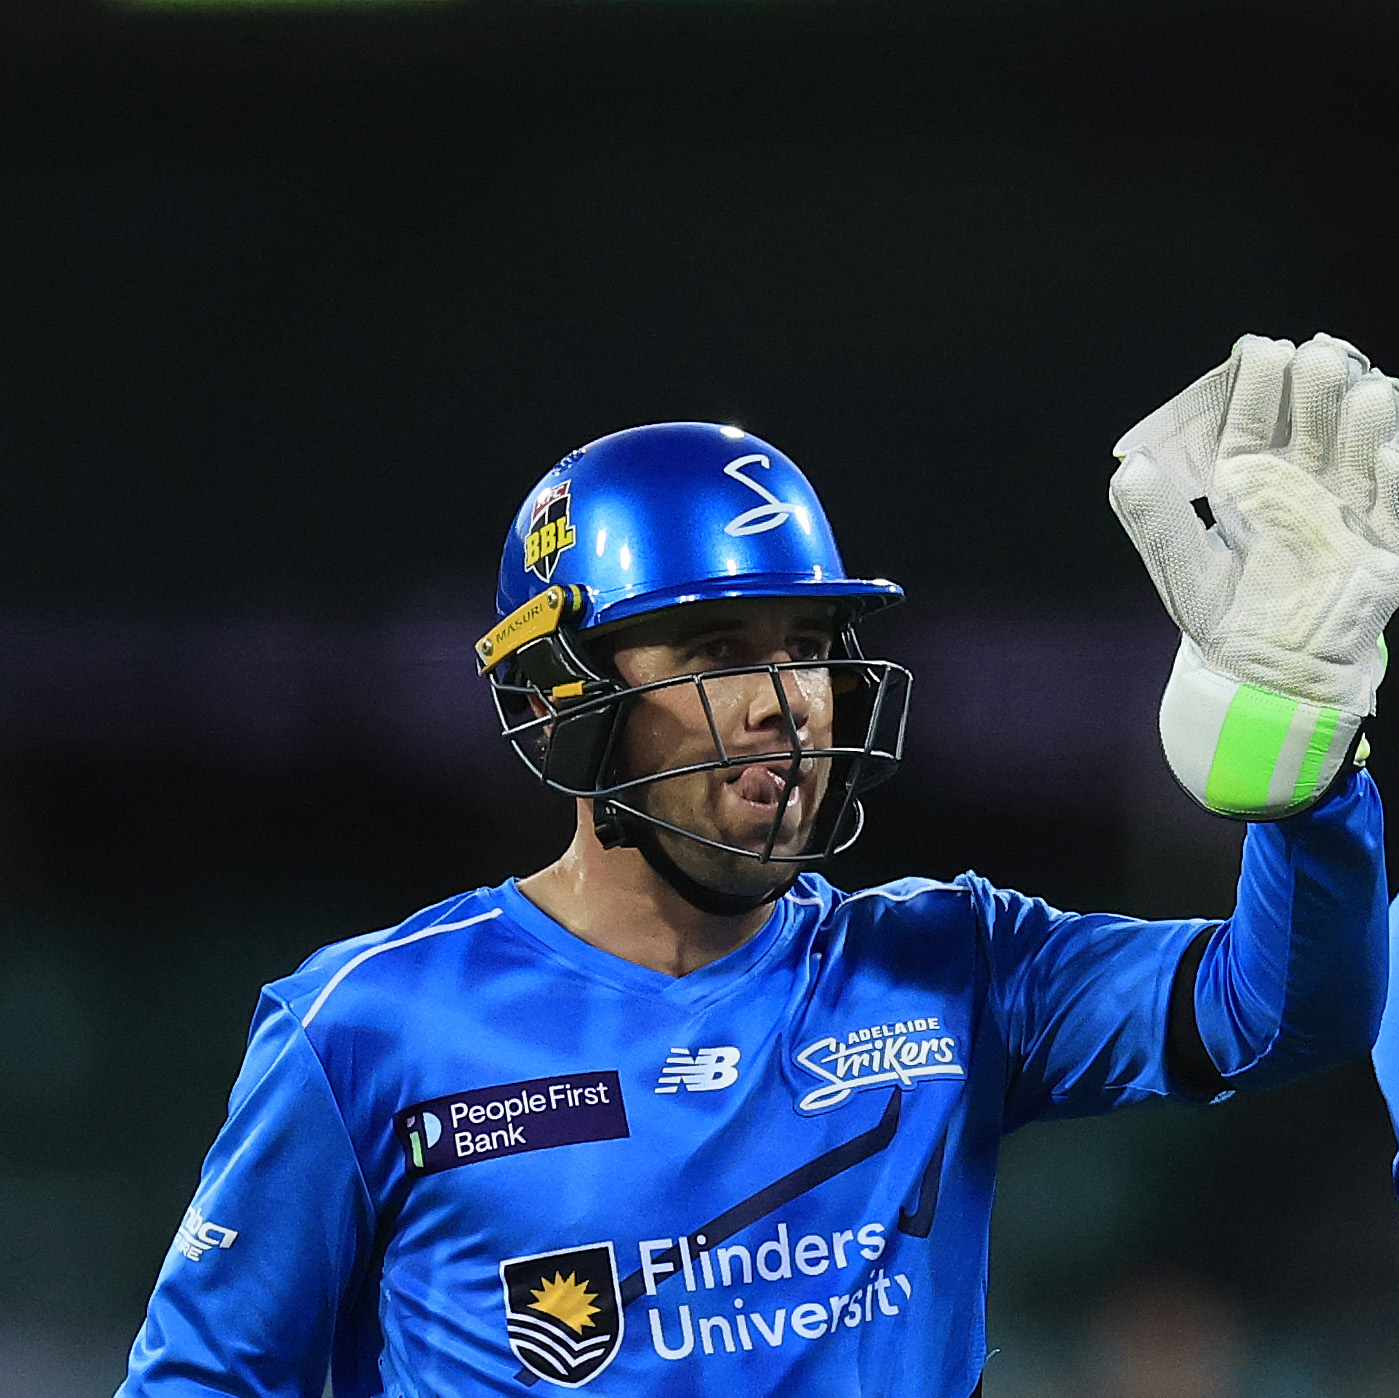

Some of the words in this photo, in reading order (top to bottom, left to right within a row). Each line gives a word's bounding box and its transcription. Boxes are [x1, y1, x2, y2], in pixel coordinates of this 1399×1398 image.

[525, 516, 574, 568] BBL
[848, 1017, 941, 1045] ADELAIDE
[453, 1124, 527, 1159] Bank
[638, 1220, 886, 1297] Flinders
